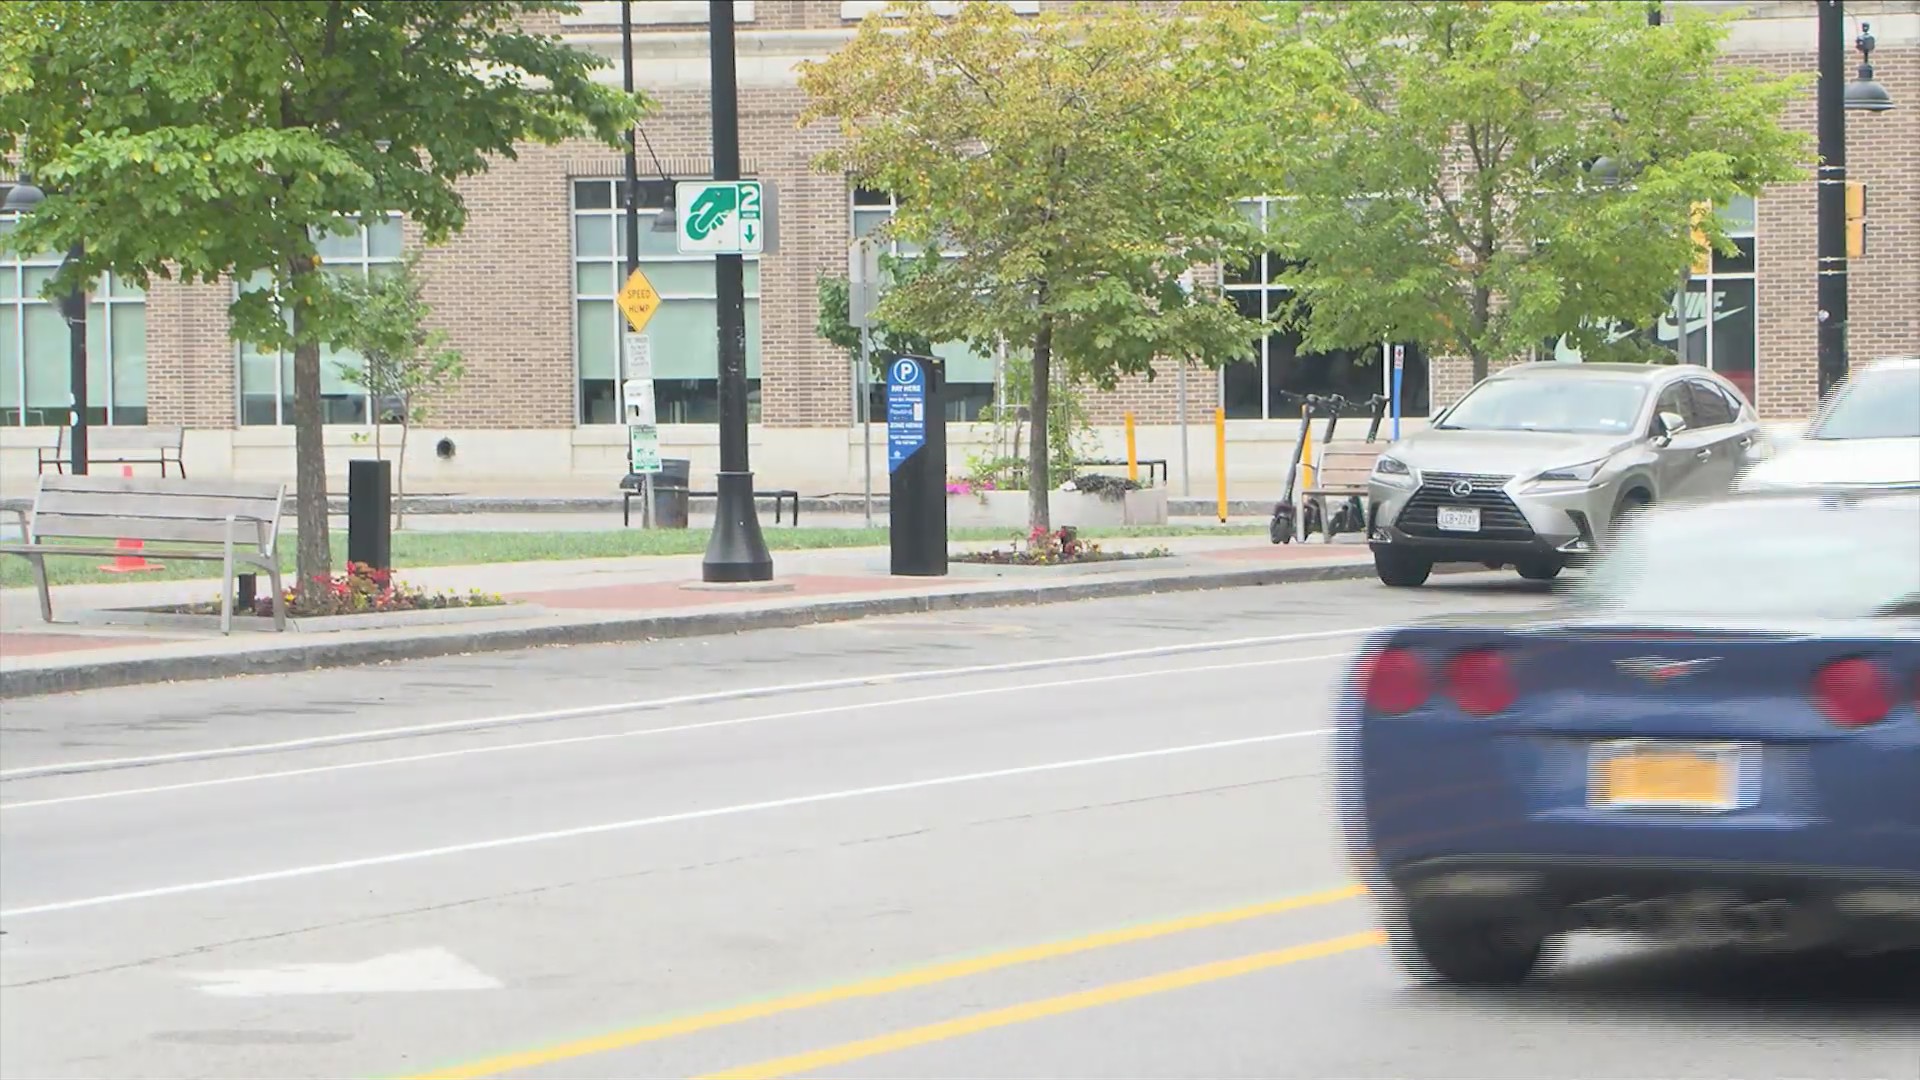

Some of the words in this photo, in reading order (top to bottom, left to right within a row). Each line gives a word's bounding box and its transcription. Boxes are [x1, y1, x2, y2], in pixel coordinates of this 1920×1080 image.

[740, 185, 759, 211] 2
[627, 289, 651, 299] SPEED
[628, 304, 650, 313] HUMP
[1667, 291, 1726, 319] NIKE
[901, 363, 913, 380] P
